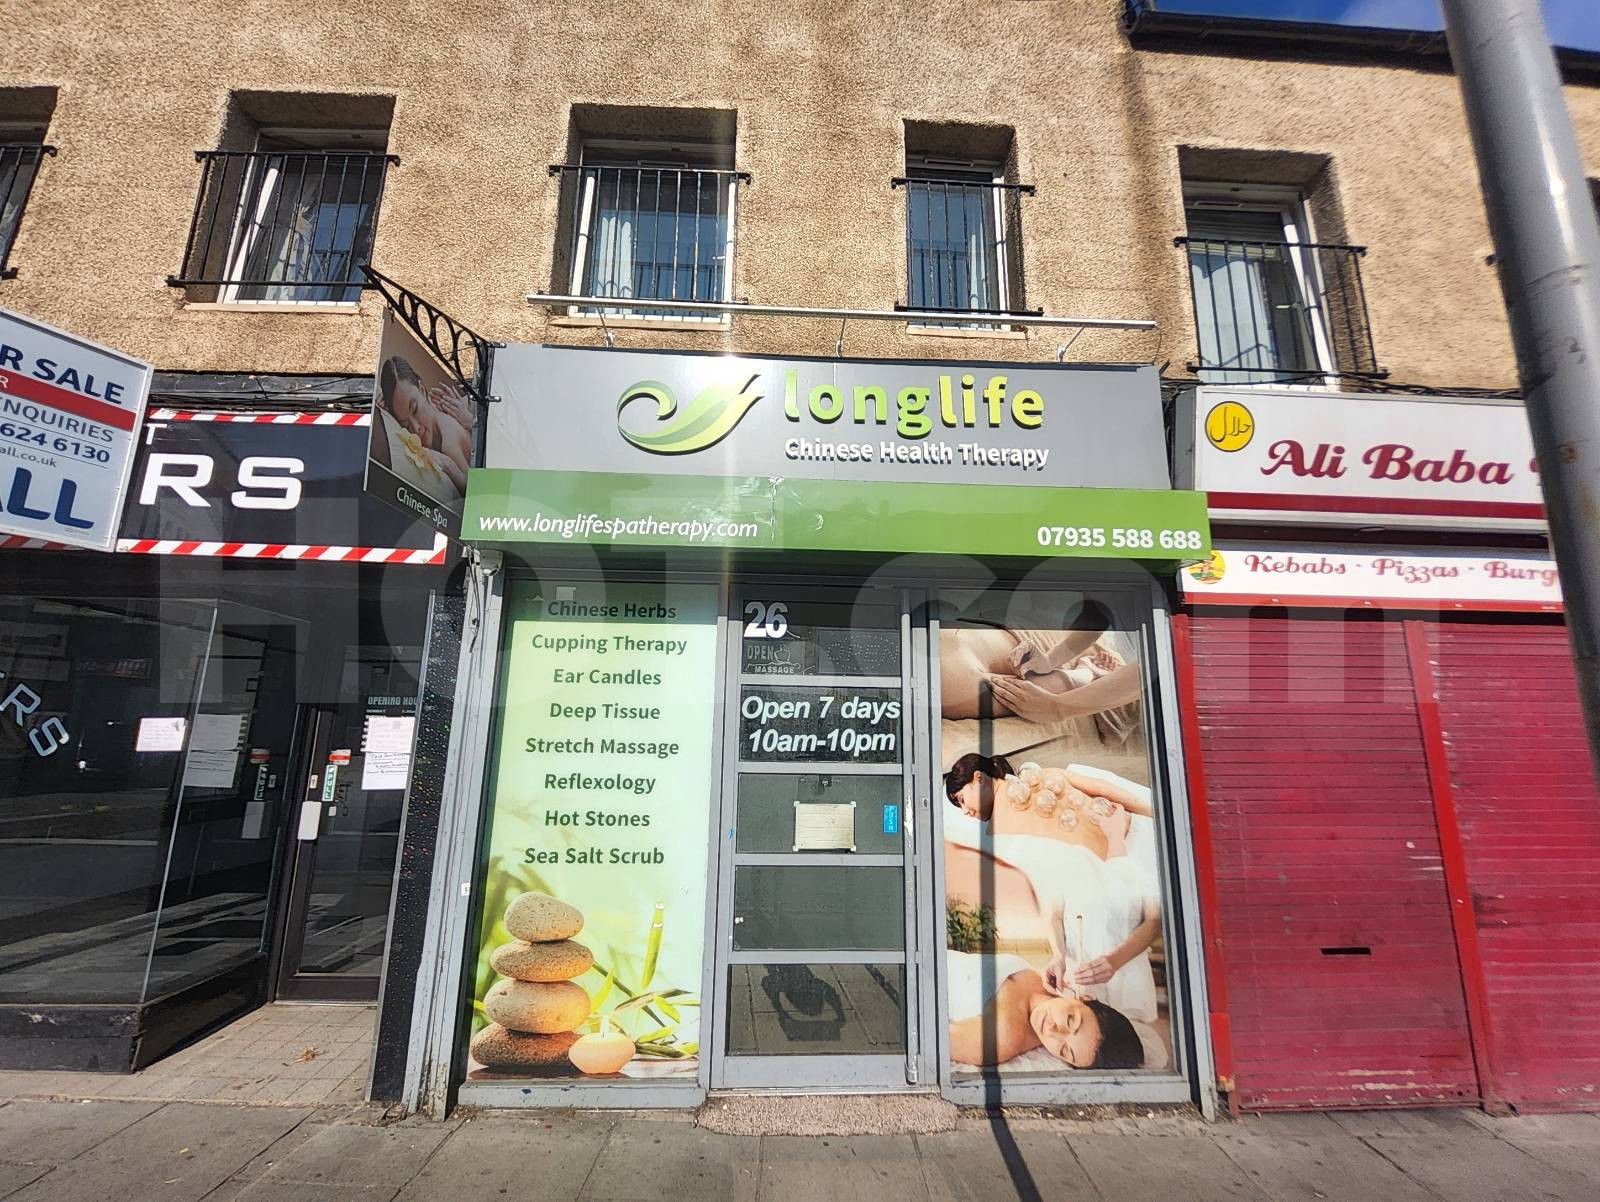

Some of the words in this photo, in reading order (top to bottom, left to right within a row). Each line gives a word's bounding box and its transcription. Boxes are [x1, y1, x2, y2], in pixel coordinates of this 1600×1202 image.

[32, 358, 125, 405] SALE
[785, 368, 1045, 438] longlife
[0, 397, 114, 443] NQUIRIES
[0, 423, 47, 446] 624
[53, 438, 110, 463] 6130
[785, 437, 873, 463] Chinese
[880, 441, 953, 465] Health
[959, 443, 1050, 470] Therapy
[1260, 439, 1348, 479] Ali
[1362, 443, 1514, 485] Baba
[0, 467, 95, 530] LL
[396, 486, 431, 518] Chinese
[432, 508, 448, 527] Spa
[479, 513, 758, 541] www.longlifespatherapy.com
[1037, 526, 1106, 548] 07935
[1112, 528, 1154, 549] 588
[1160, 530, 1202, 550] 688
[1244, 554, 1347, 576] Kebabs
[1371, 557, 1459, 583] Pizzas
[547, 601, 619, 618] Chinese
[624, 603, 676, 618] Herbs
[744, 601, 788, 638] 26
[532, 634, 608, 654] Cupping
[613, 636, 688, 655] Therapy
[747, 645, 774, 660] OPEN
[553, 668, 584, 684] Ear
[589, 669, 662, 685] Candles
[754, 666, 795, 674] MASSAGE
[0, 671, 69, 756] RS
[367, 696, 401, 706] OPENING
[550, 702, 596, 721] Deep
[602, 703, 661, 720] Tissue
[742, 695, 810, 724] Open
[820, 697, 834, 719] 7
[841, 696, 901, 724] days
[525, 737, 594, 754] Stretch
[600, 739, 680, 758] Massage
[749, 729, 896, 757] 10am-10pm
[324, 773, 335, 799] PULL
[544, 773, 656, 794] Reflexology
[545, 810, 580, 826] Hot
[585, 811, 650, 827] Stones
[524, 848, 559, 864] Sea
[565, 847, 603, 864] Salt
[609, 847, 665, 865] Scrub
